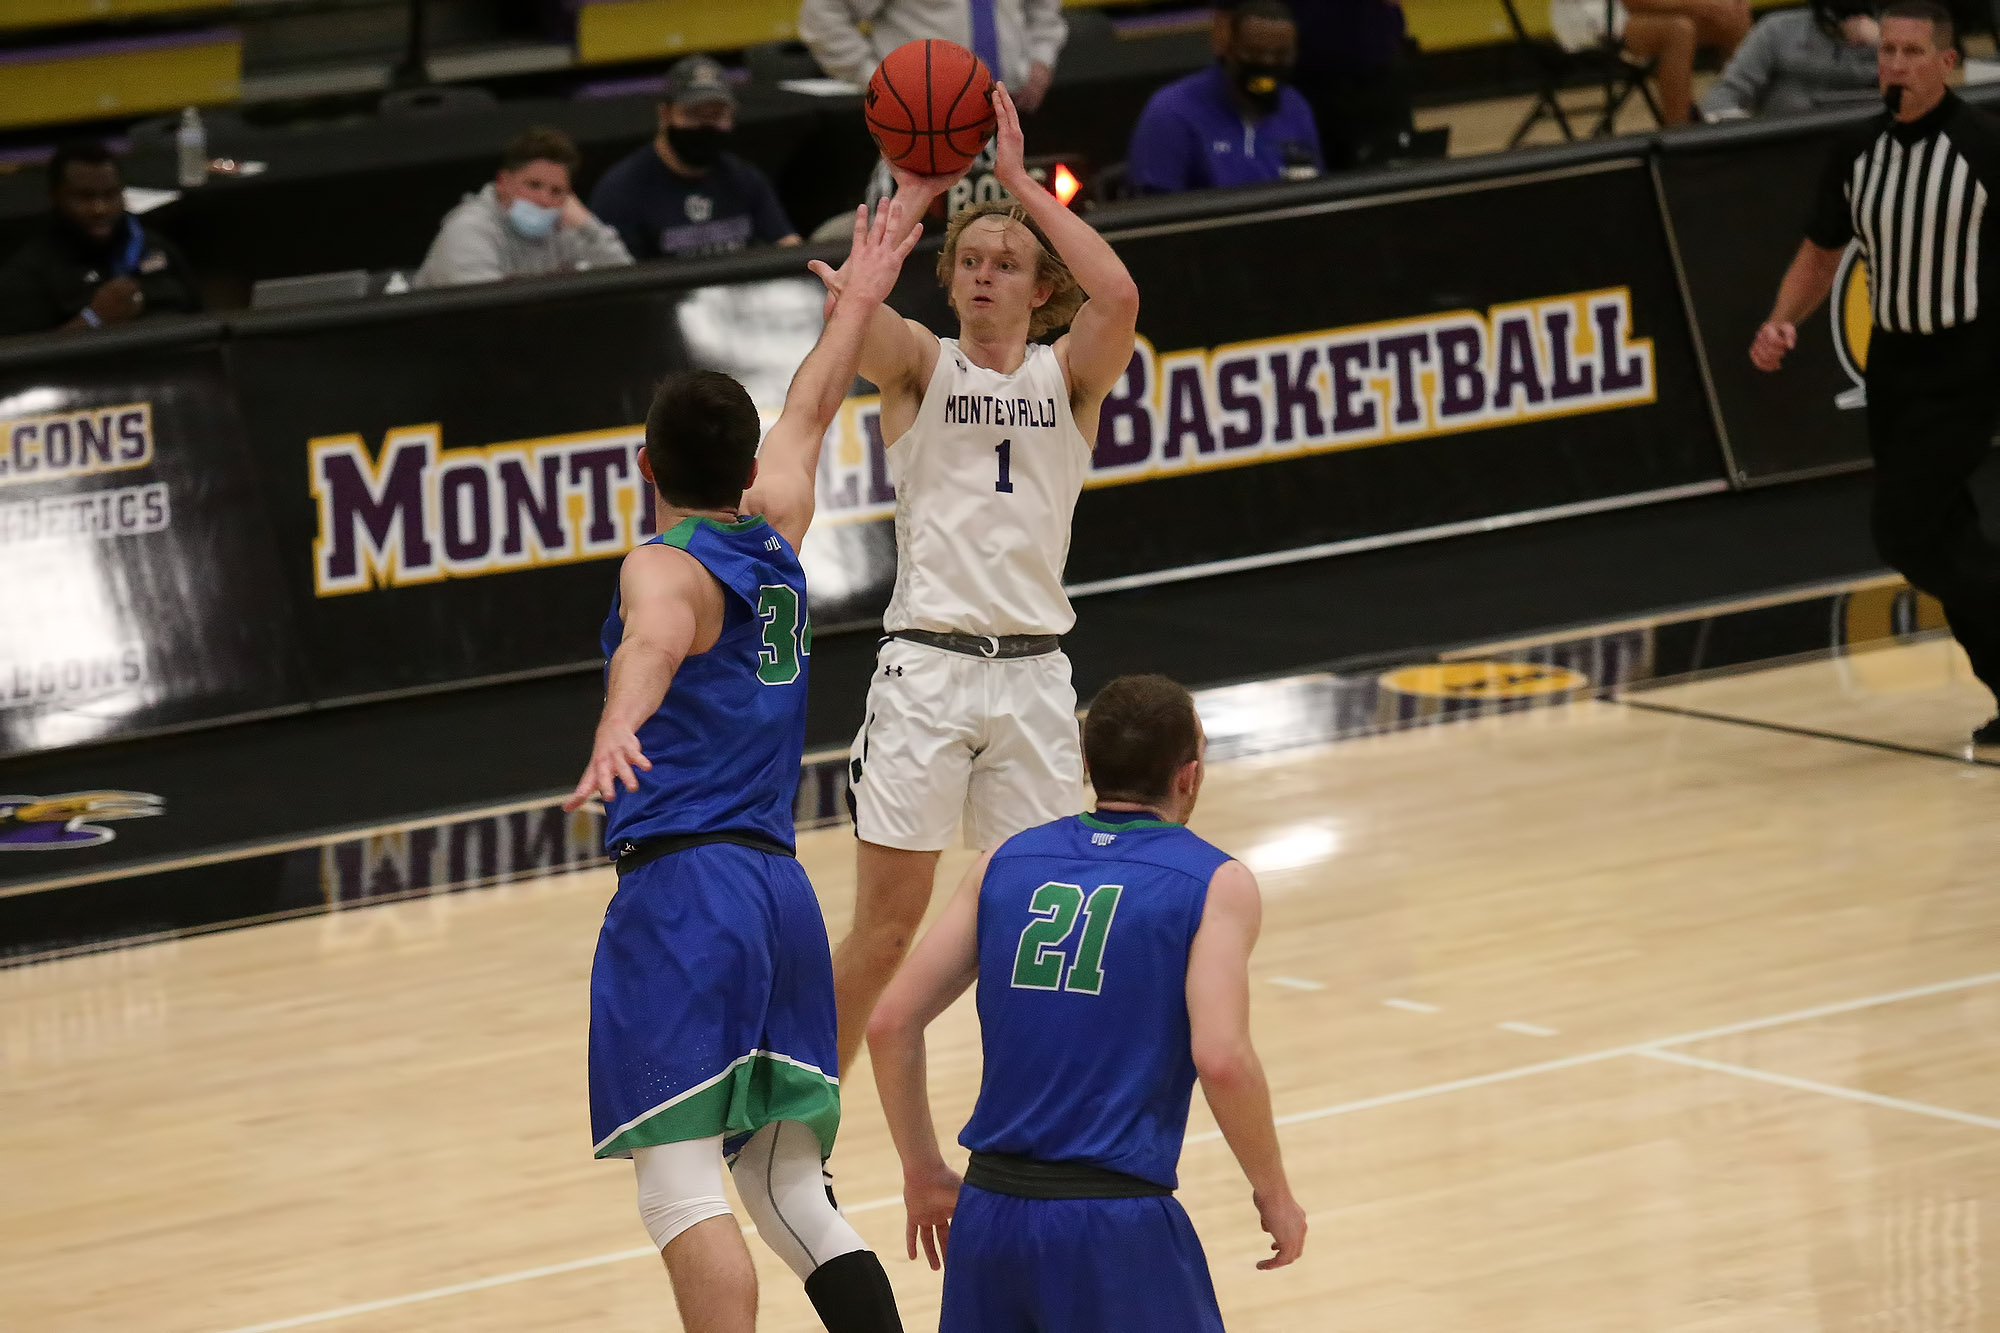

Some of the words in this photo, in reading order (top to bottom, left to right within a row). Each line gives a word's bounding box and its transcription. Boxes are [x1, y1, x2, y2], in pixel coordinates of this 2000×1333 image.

[945, 394, 1056, 428] MONTEVALLO
[1084, 286, 1657, 490] BASKETBALL
[0, 402, 153, 485] CONS
[994, 438, 1014, 494] 1
[756, 583, 812, 686] 3
[1091, 832, 1116, 846] UWF
[1010, 881, 1123, 996] 21
